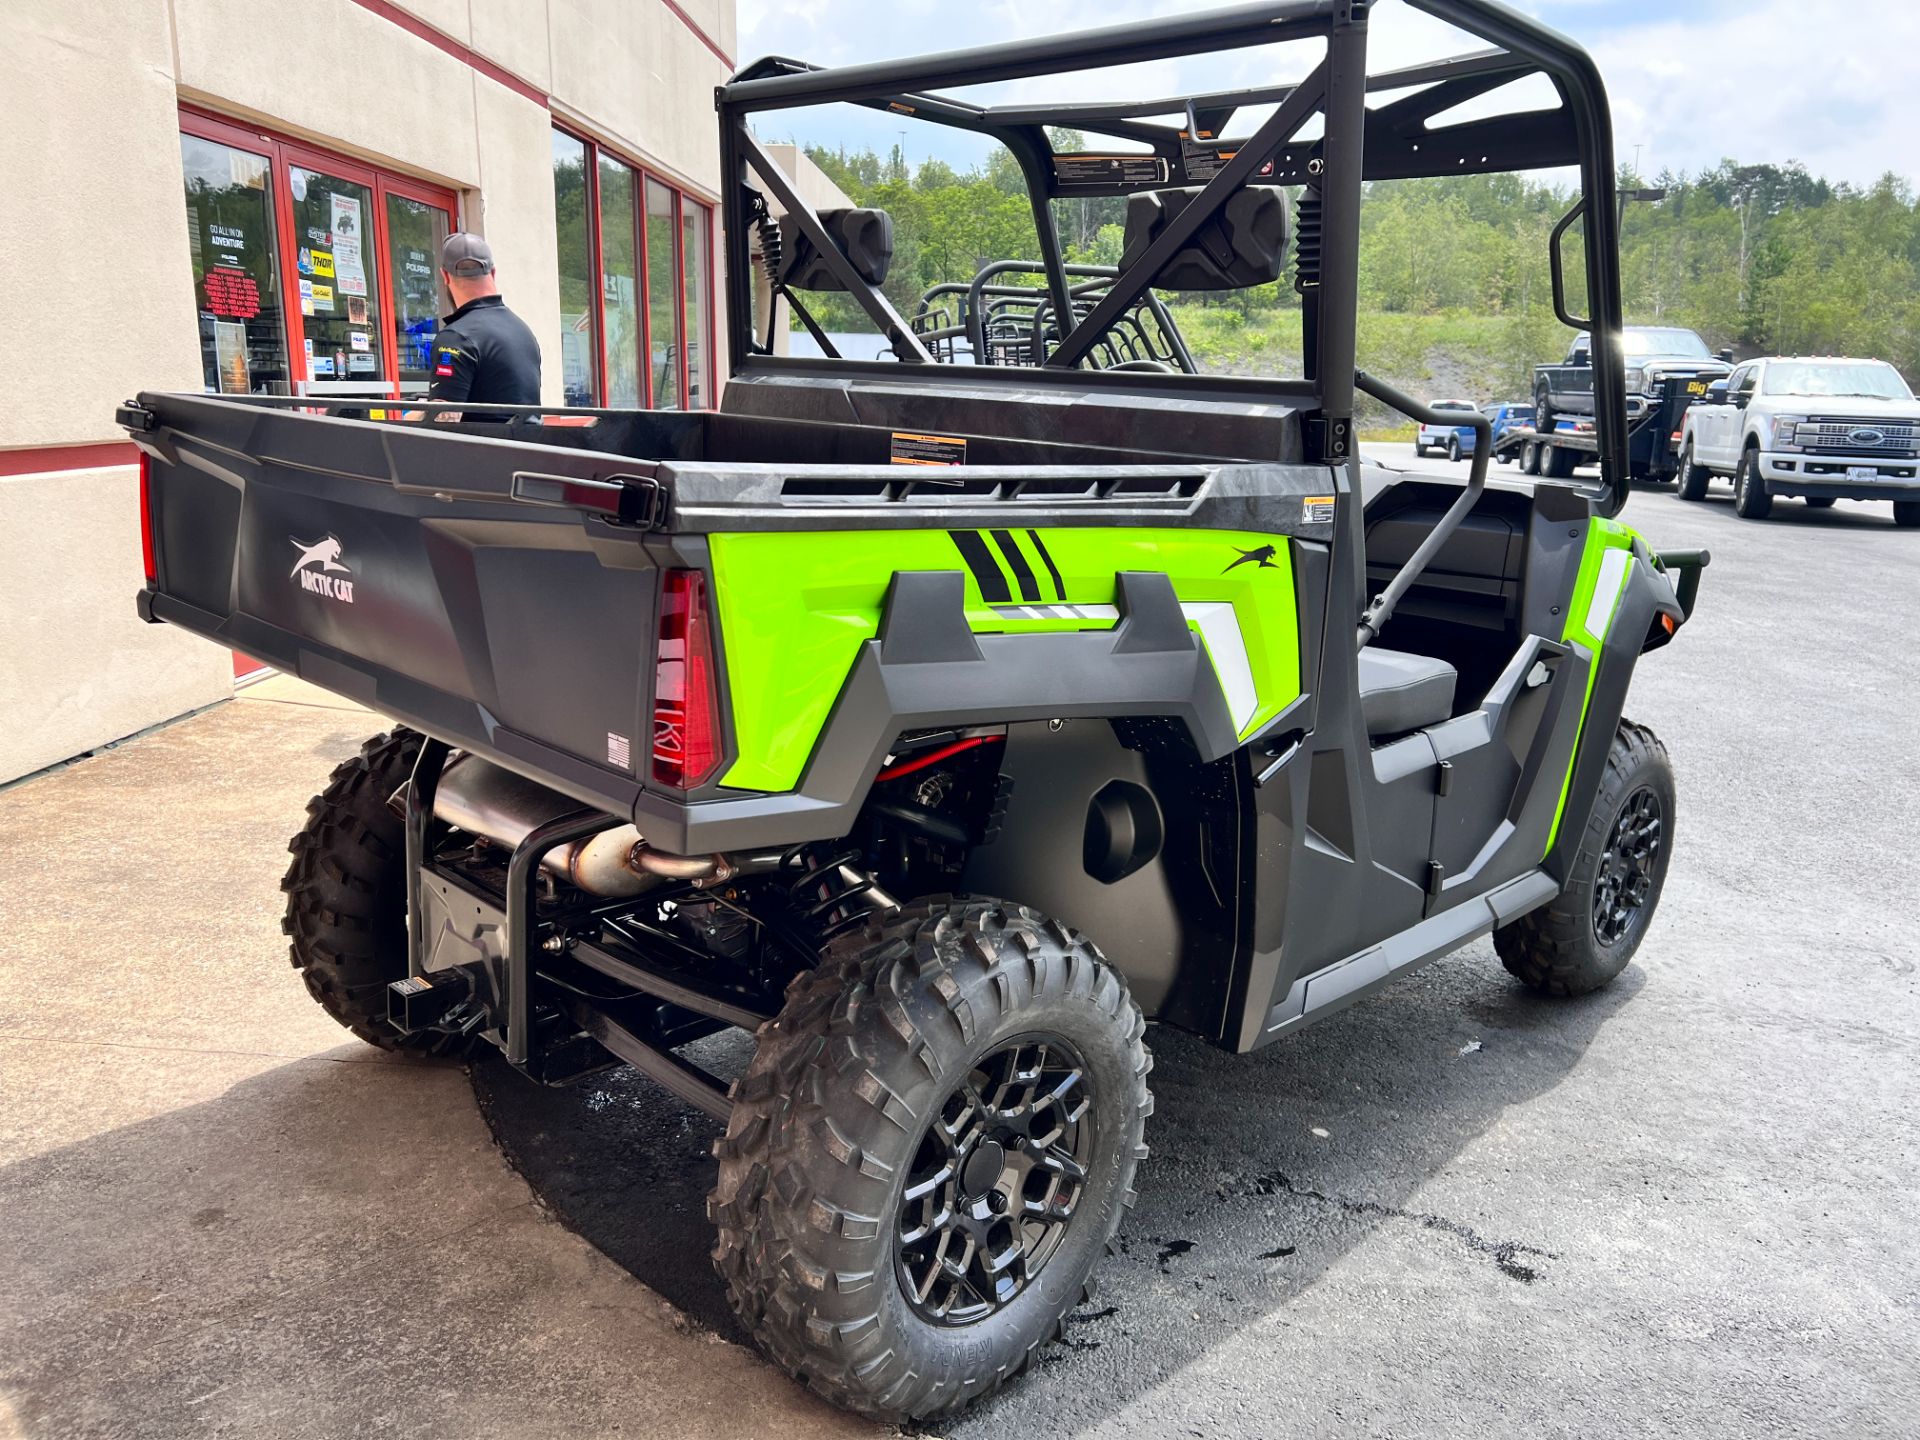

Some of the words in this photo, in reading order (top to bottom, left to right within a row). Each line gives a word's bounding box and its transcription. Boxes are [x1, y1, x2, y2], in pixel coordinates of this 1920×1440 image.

[210, 224, 218, 234] GO
[219, 226, 229, 236] ALL
[211, 235, 245, 250] ADVENTURE
[312, 255, 333, 270] THOR
[405, 262, 431, 275] POLARIS
[301, 282, 312, 291] VISA
[1686, 381, 1707, 396] Big
[300, 567, 334, 598] ARCTIC
[333, 578, 353, 604] CAT
